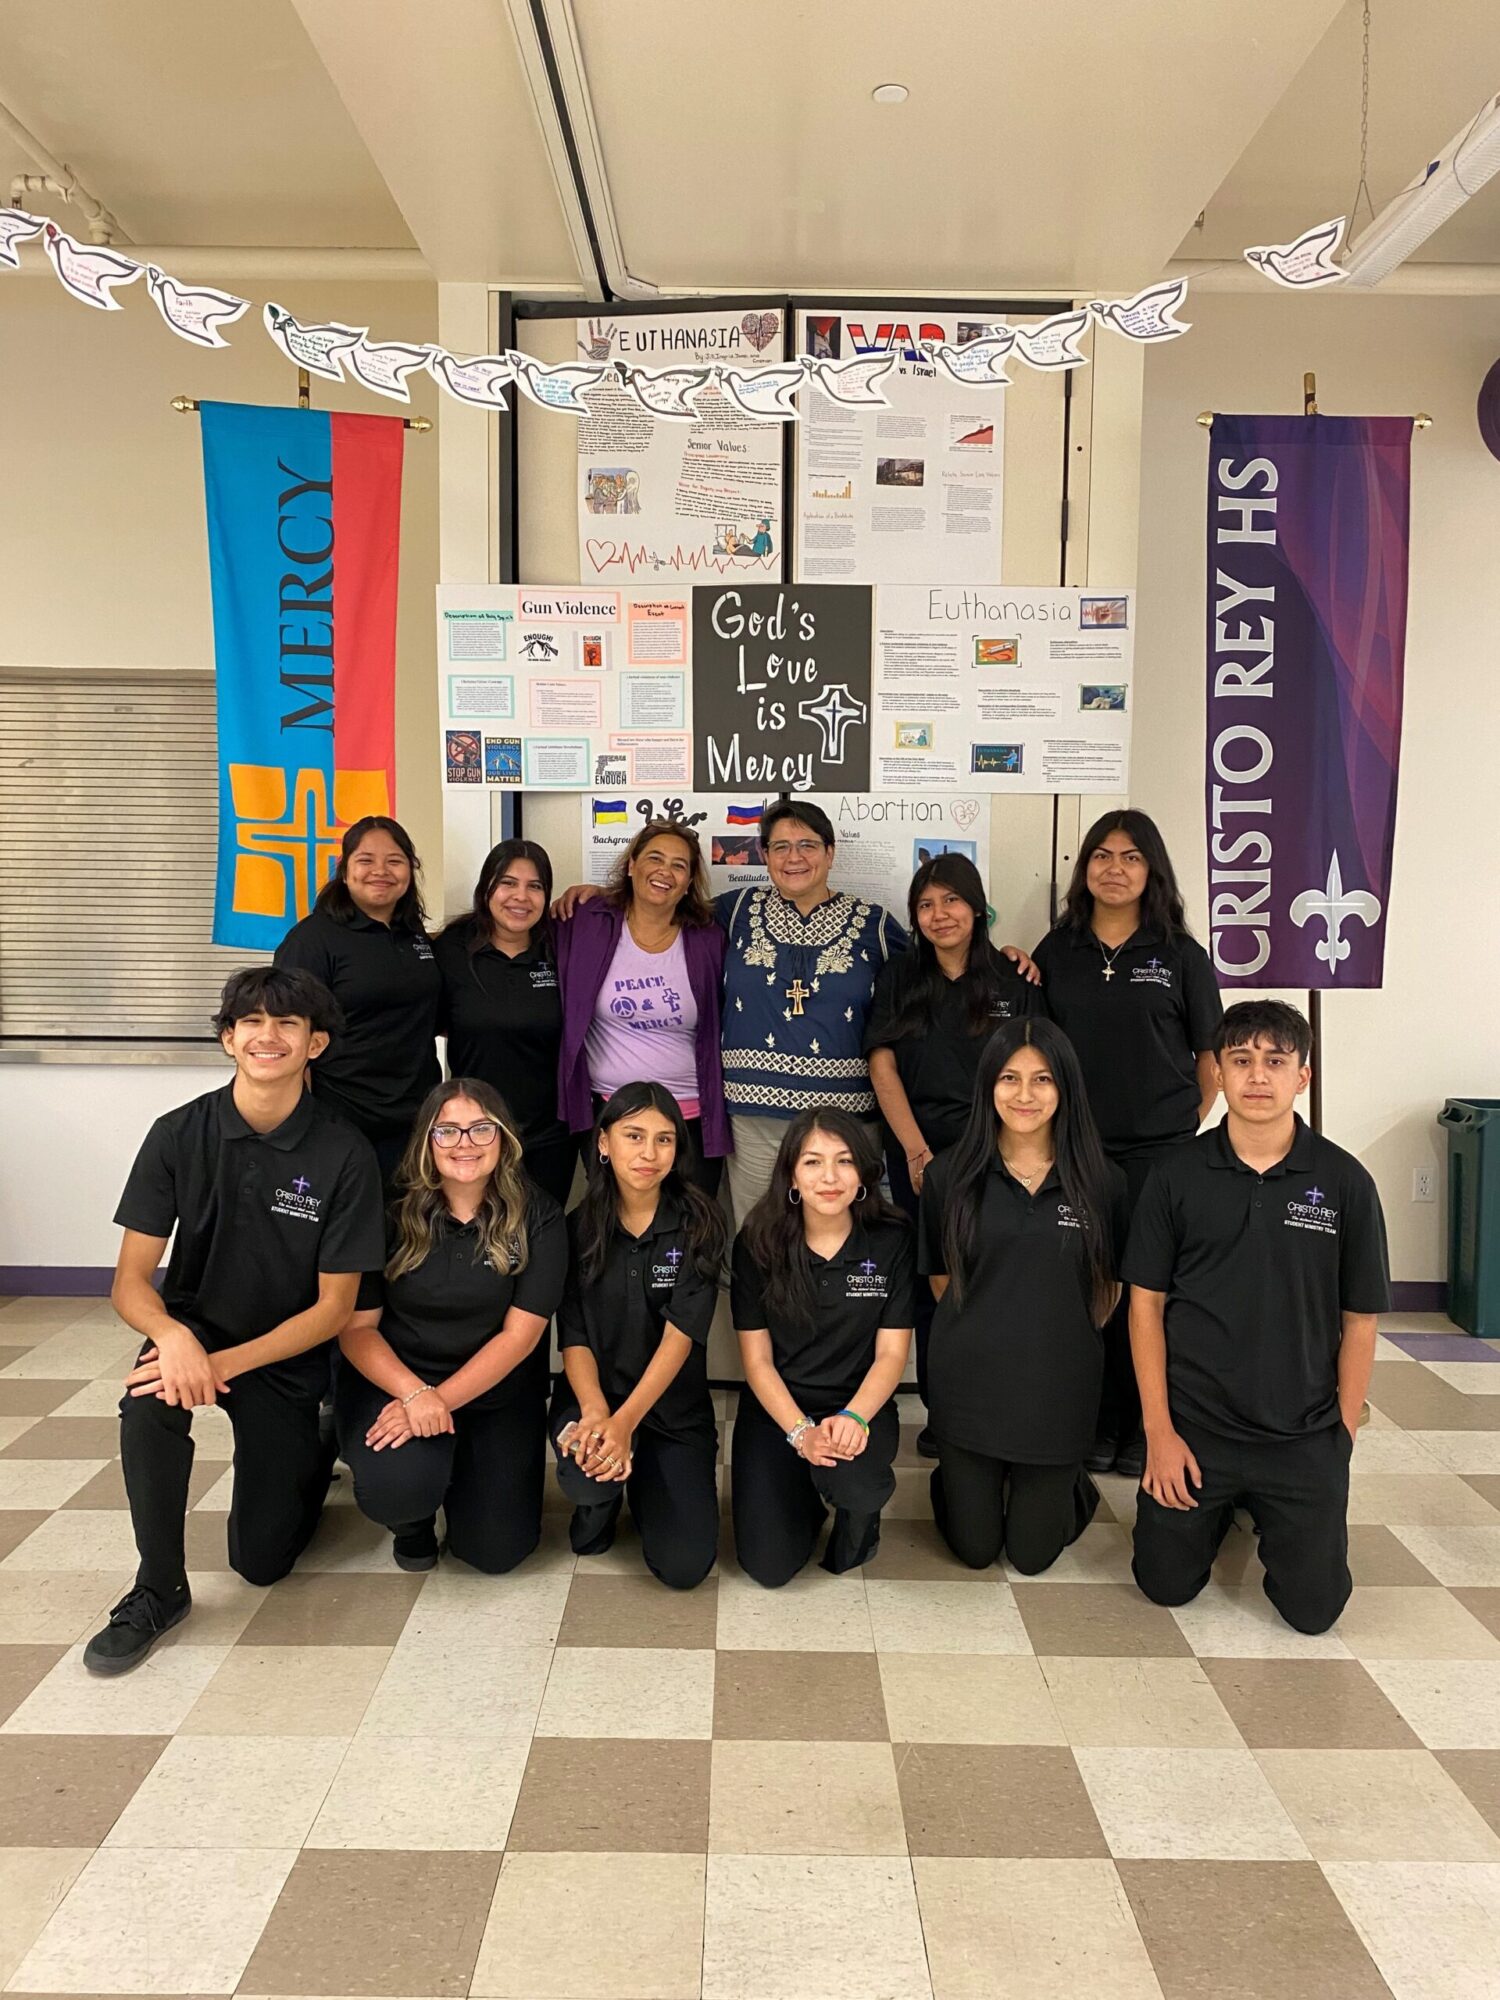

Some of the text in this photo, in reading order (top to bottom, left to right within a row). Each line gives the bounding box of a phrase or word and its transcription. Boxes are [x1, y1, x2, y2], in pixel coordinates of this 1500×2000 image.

[619, 326, 740, 351] EUTHANASIA
[899, 364, 937, 377] vs Israel
[687, 438, 712, 450] Senior
[277, 456, 336, 737] MERCY
[522, 600, 616, 615] Gun Violence
[928, 589, 1072, 622] Euthanasia
[711, 591, 816, 641] God's
[736, 644, 818, 694] Love
[756, 696, 786, 730] is
[1211, 457, 1279, 977] CRISTO REY HS
[707, 733, 816, 791] Mercy
[447, 767, 481, 777] STOP GUN
[595, 775, 627, 785] ENOUGH
[838, 796, 943, 821] Abortion
[839, 829, 861, 839] Values
[727, 873, 769, 882] Beatitudes
[614, 976, 665, 991] PEACE
[641, 998, 655, 1011] &
[627, 1014, 683, 1030] MERCY
[275, 1188, 305, 1203] CRISTO
[1287, 1201, 1338, 1219] CRISTO REY
[846, 1274, 888, 1283] CRISTO REY
